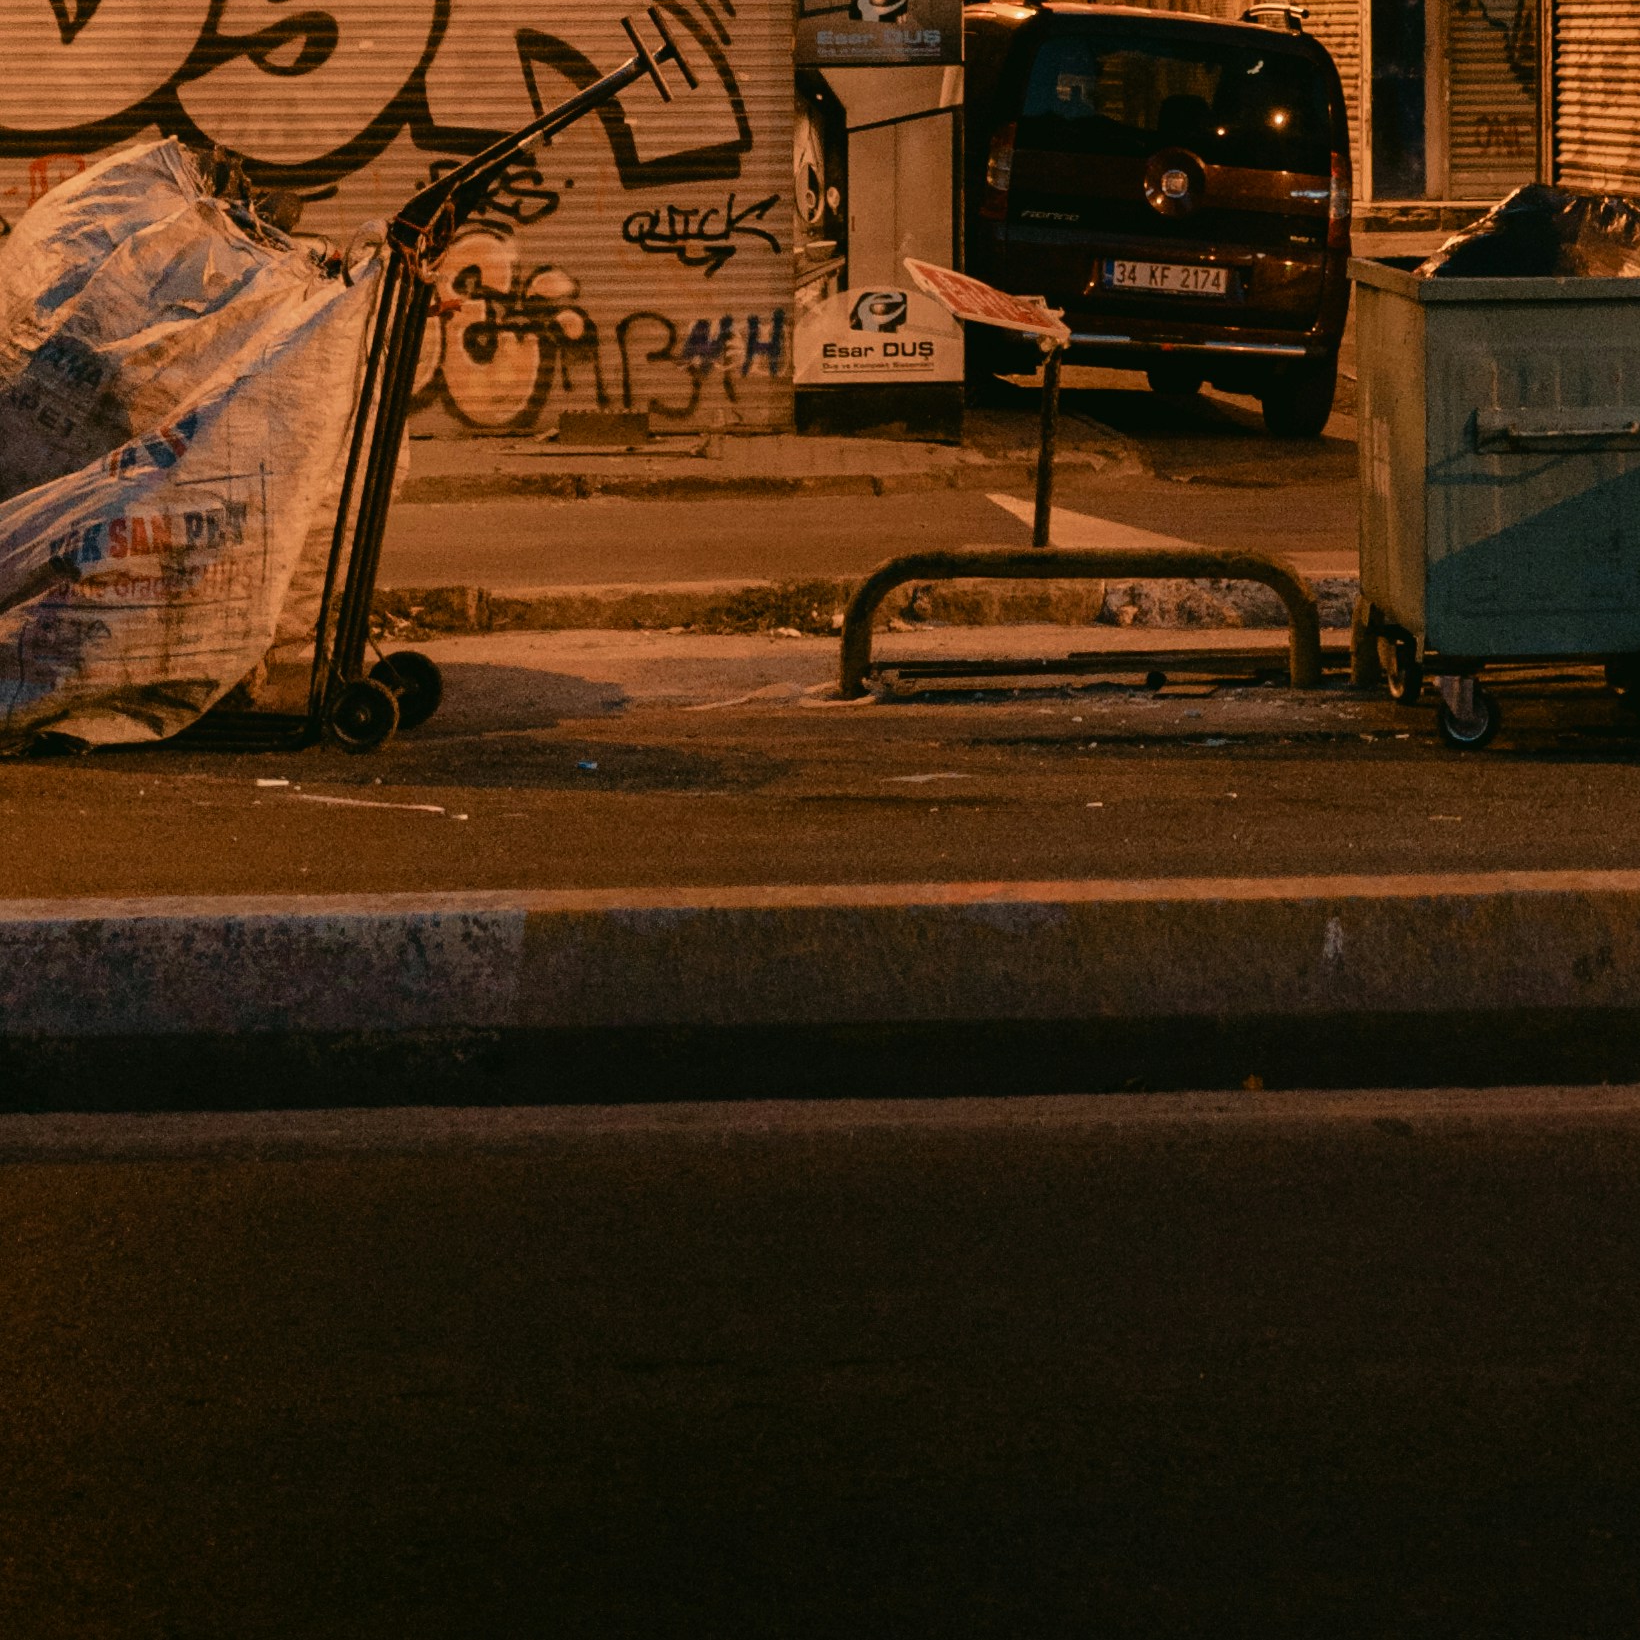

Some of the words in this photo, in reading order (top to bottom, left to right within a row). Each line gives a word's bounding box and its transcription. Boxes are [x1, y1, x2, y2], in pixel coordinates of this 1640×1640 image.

[1115, 264, 1138, 283] 34
[1149, 266, 1171, 287] KF
[1179, 269, 1222, 290] 2174
[822, 343, 874, 358] Esar
